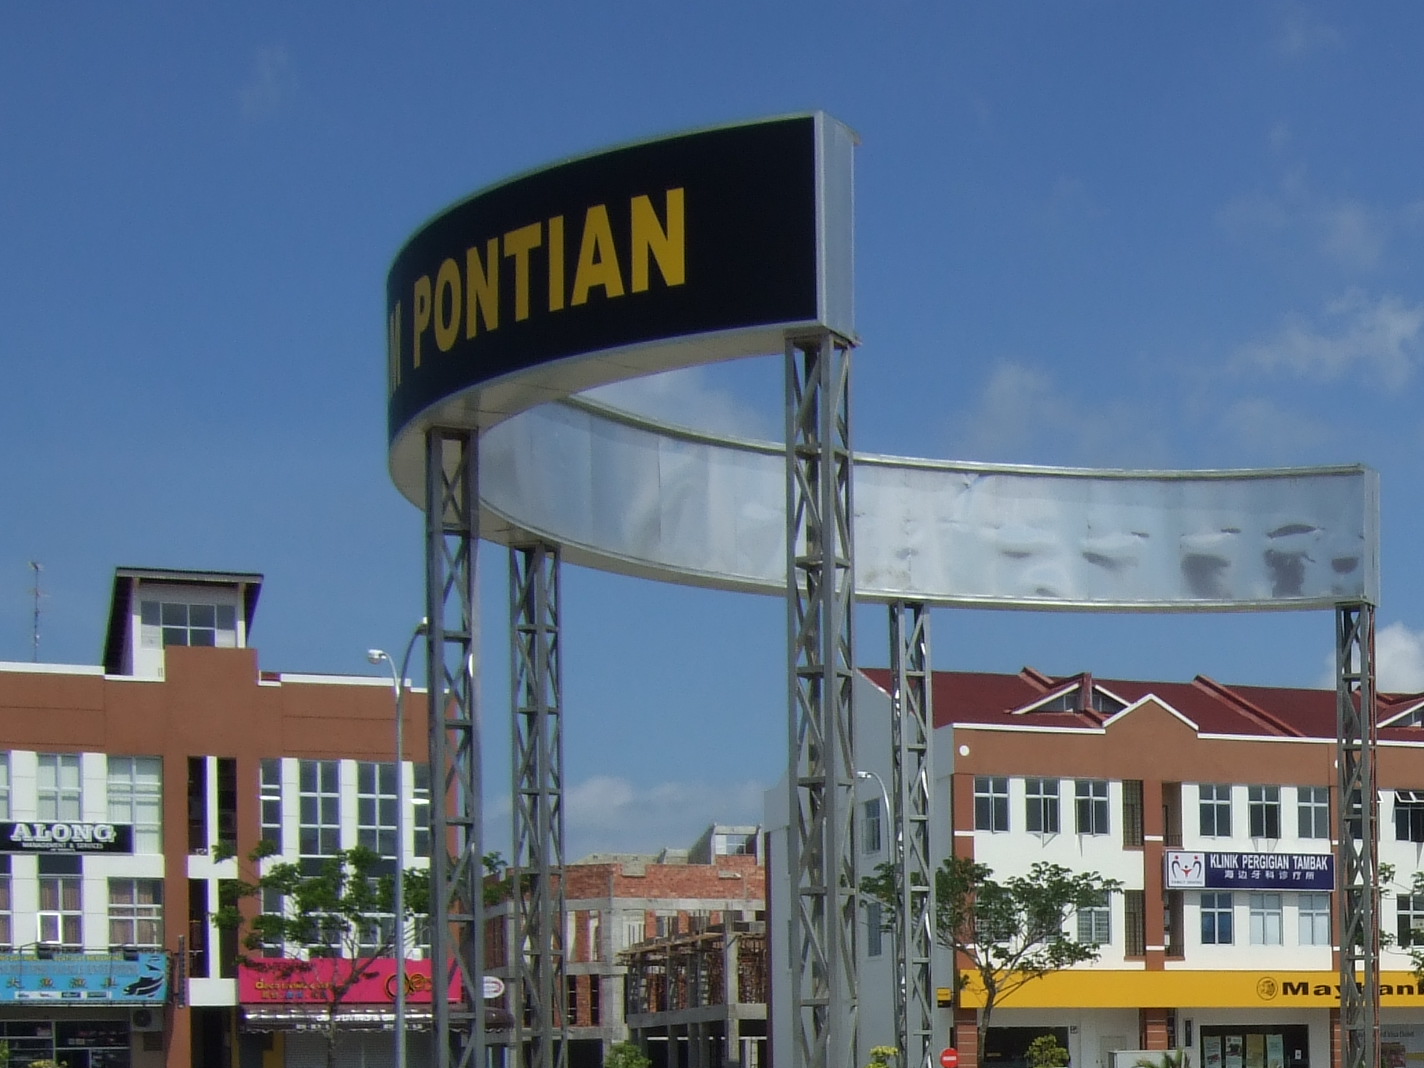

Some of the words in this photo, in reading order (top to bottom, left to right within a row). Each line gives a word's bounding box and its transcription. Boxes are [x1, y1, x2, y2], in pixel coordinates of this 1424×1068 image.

[413, 187, 686, 369] PONTIAN
[10, 823, 116, 842] ALONG
[1210, 854, 1239, 869] KLINIK
[1242, 855, 1289, 869] PERGIGIAN
[1293, 856, 1328, 871] TAMBAK
